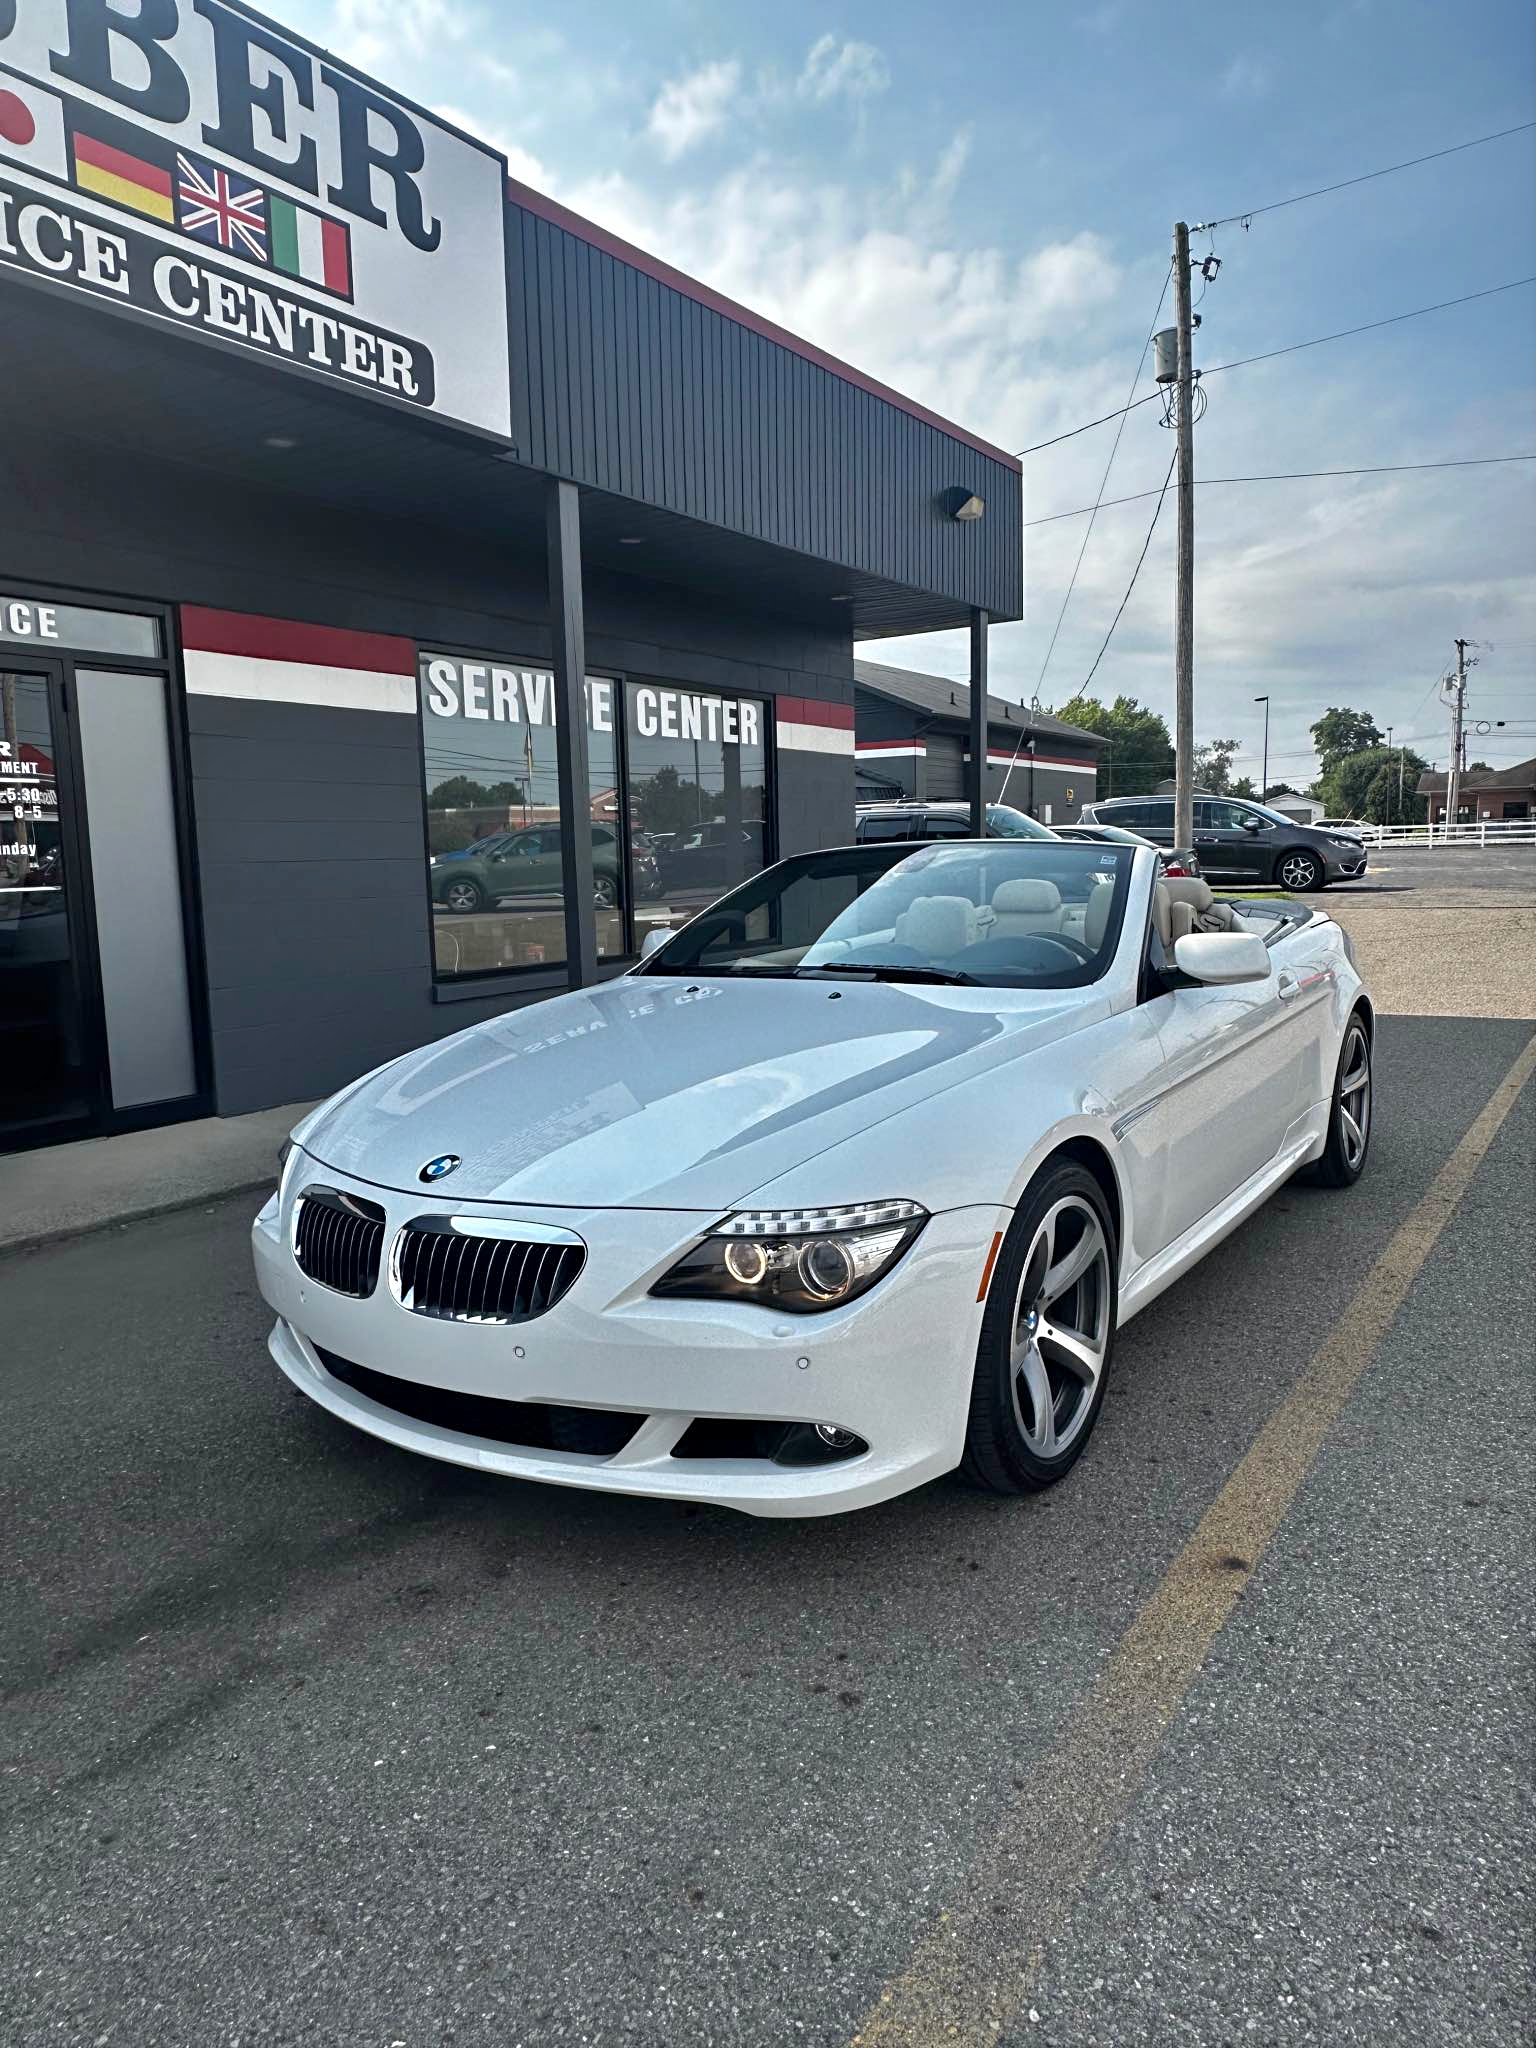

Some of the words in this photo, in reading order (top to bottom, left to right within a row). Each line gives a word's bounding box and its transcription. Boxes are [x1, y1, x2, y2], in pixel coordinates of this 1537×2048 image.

[0, 0, 441, 252] BER
[153, 255, 419, 396] CENTER
[0, 603, 58, 638] CE
[429, 660, 612, 731] SERVE
[636, 689, 758, 745] CENTER
[14, 805, 41, 818] 8-5
[0, 842, 36, 856] nday
